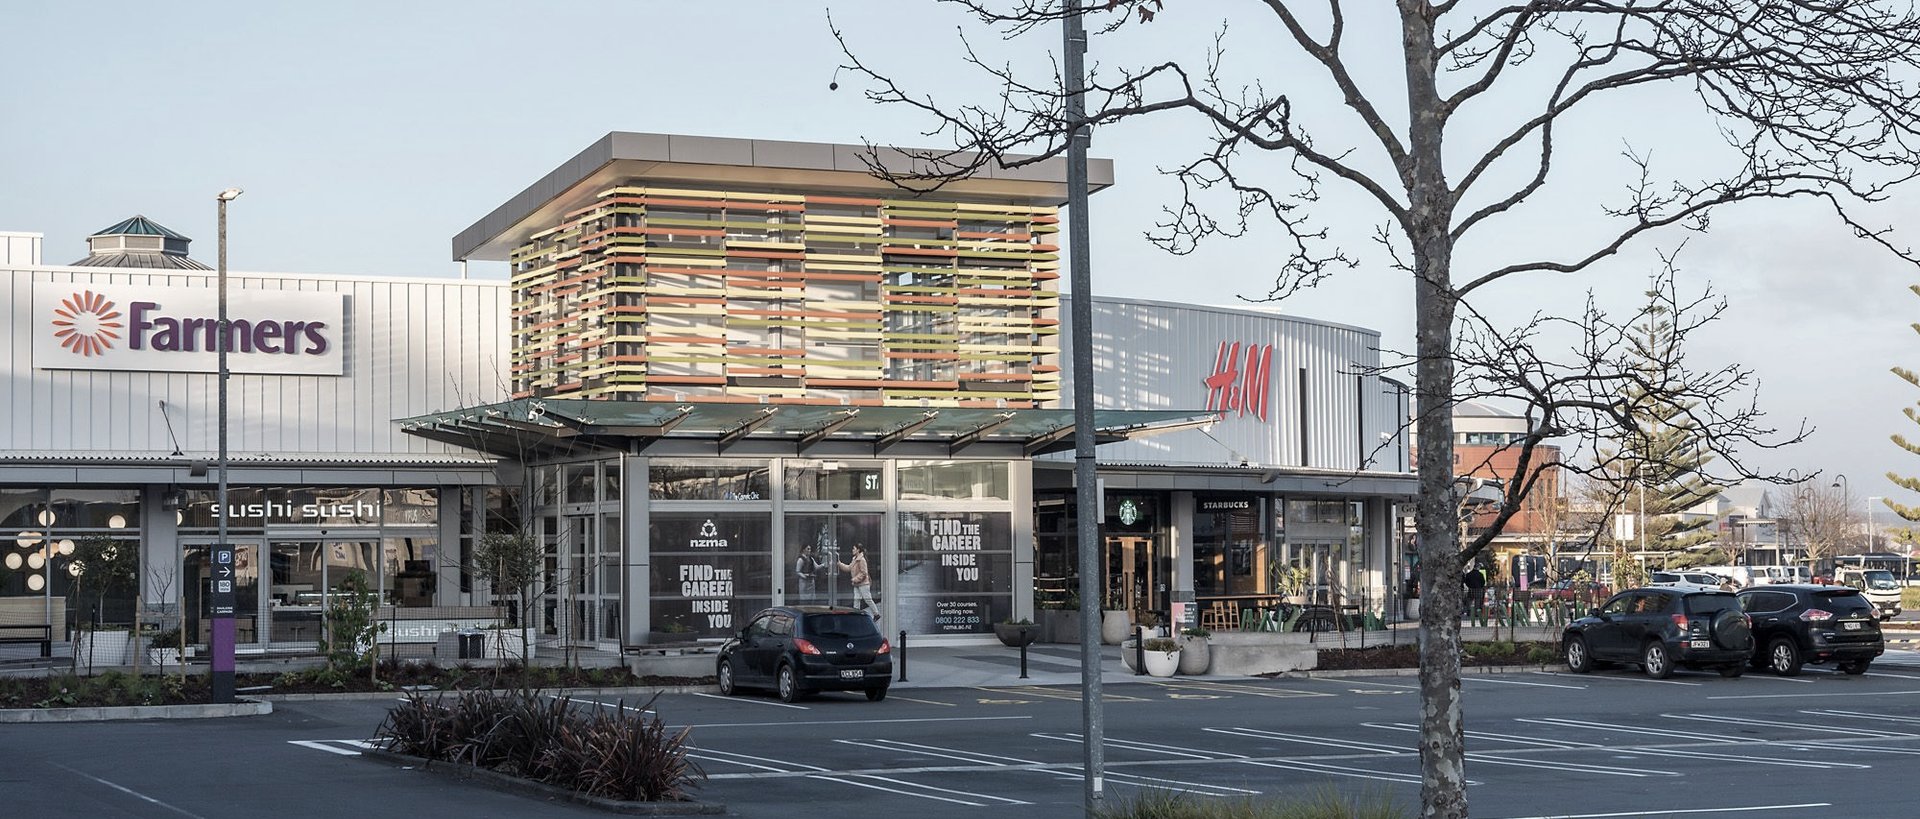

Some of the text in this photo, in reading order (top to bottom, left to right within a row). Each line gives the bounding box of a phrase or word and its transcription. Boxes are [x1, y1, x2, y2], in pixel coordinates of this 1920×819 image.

[129, 301, 327, 355] Farmers
[1204, 341, 1272, 423] H&M
[865, 474, 879, 490] ST
[210, 500, 380, 518] sushi sushi
[1203, 501, 1249, 509] STARBUCKS
[930, 520, 980, 535] FIND THE
[690, 539, 728, 548] nzma
[932, 535, 981, 551] CAREER
[942, 554, 976, 566] INSIDE
[680, 565, 733, 581] FIND THE
[956, 567, 979, 581] YOU
[681, 581, 733, 597] CAREER
[692, 601, 729, 613] INSIDE
[707, 614, 732, 628] YOU
[387, 625, 437, 638] sushi
